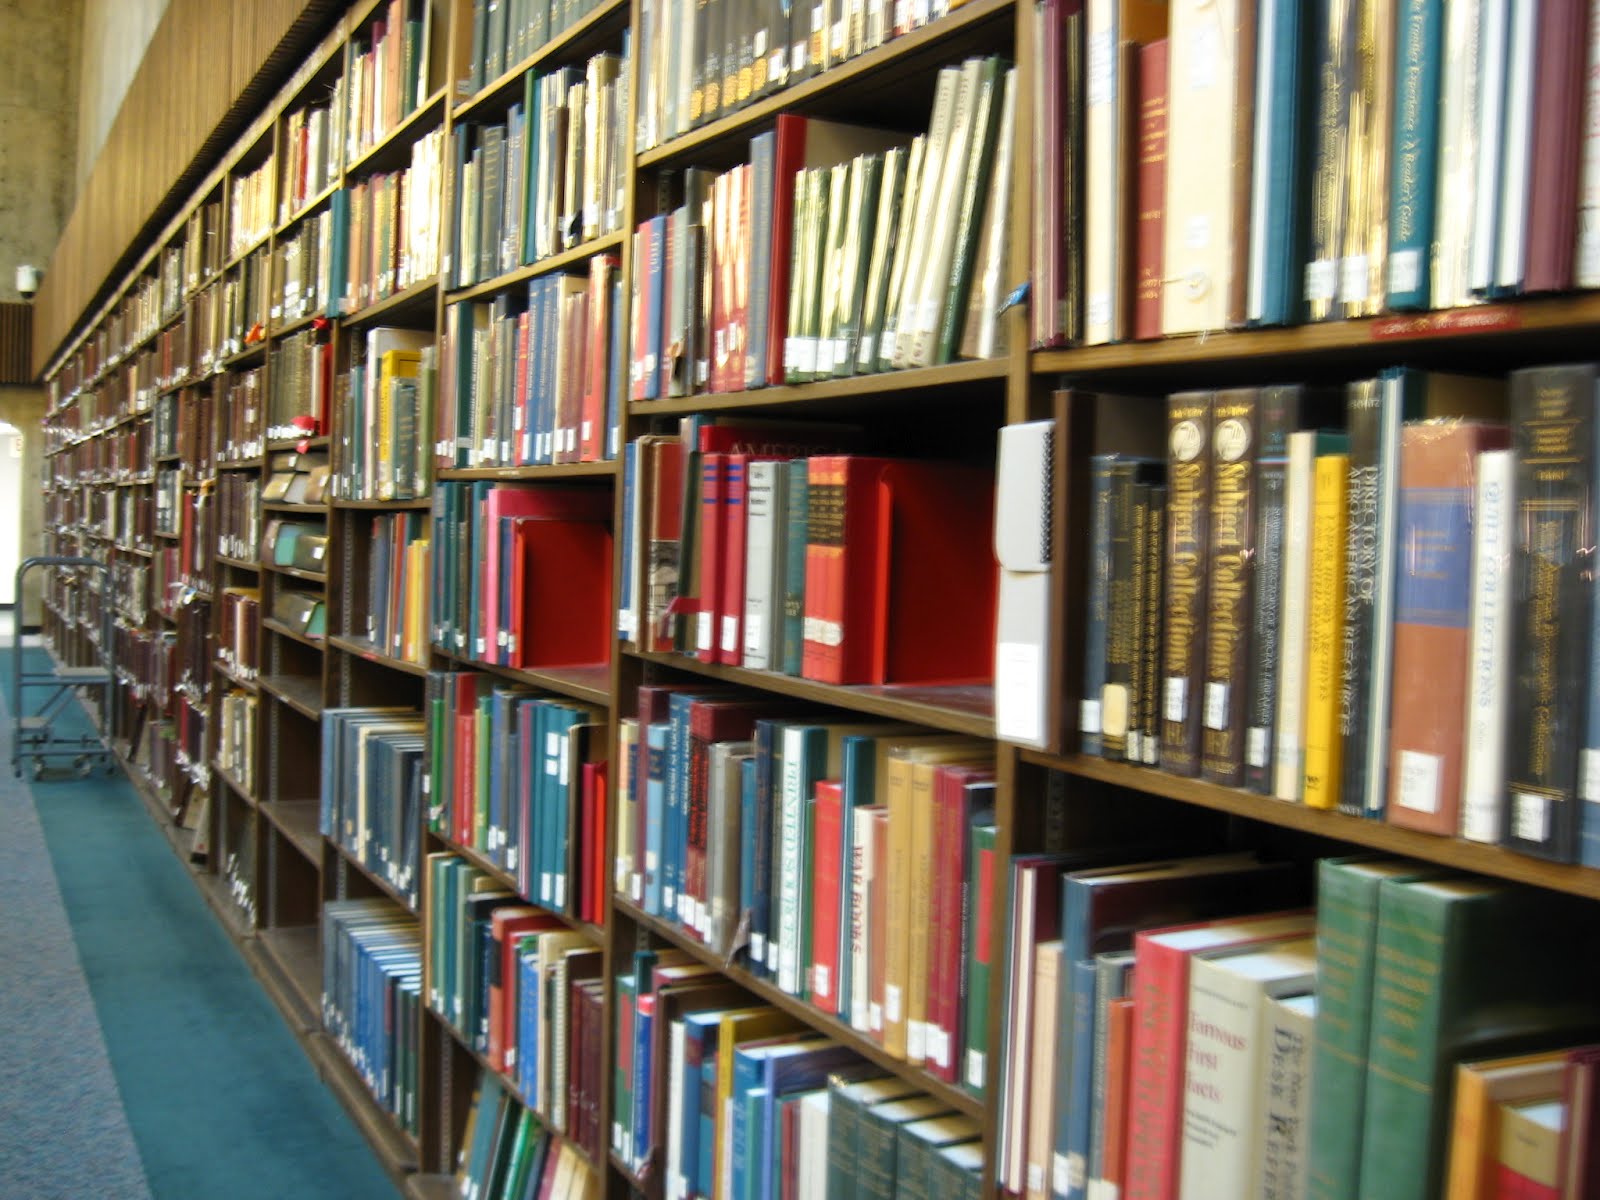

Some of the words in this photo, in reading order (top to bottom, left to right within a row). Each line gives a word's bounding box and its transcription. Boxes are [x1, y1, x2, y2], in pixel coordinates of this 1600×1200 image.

[1408, 16, 1423, 64] Frontier
[1404, 66, 1420, 131] Experience
[1401, 153, 1414, 202] Reader's
[1399, 205, 1411, 243] Guide
[1172, 463, 1203, 545] Subject
[1213, 463, 1246, 549] Subject
[1361, 465, 1379, 574] DIRECTORY
[1323, 514, 1336, 561] LABOR
[1343, 466, 1360, 621] AFRO-AMERICAN
[1268, 551, 1280, 607] DIRECTORY
[1312, 548, 1324, 599] UNITED
[1321, 565, 1335, 627] HISTORY
[1360, 577, 1375, 606] OF
[1167, 553, 1198, 675] Collections
[1209, 554, 1243, 680] Collections
[1311, 602, 1323, 655] STATES
[1479, 556, 1499, 709] COLLECTIONS
[1319, 631, 1331, 703] ARCHIVES
[1340, 626, 1355, 736] RESOURCES
[785, 761, 798, 852] PRINTED
[851, 845, 864, 886] WAR
[782, 856, 796, 951] SOURCES
[849, 890, 863, 953] BOOKS
[1188, 1039, 1219, 1072] First
[1190, 1010, 1247, 1052] Famous
